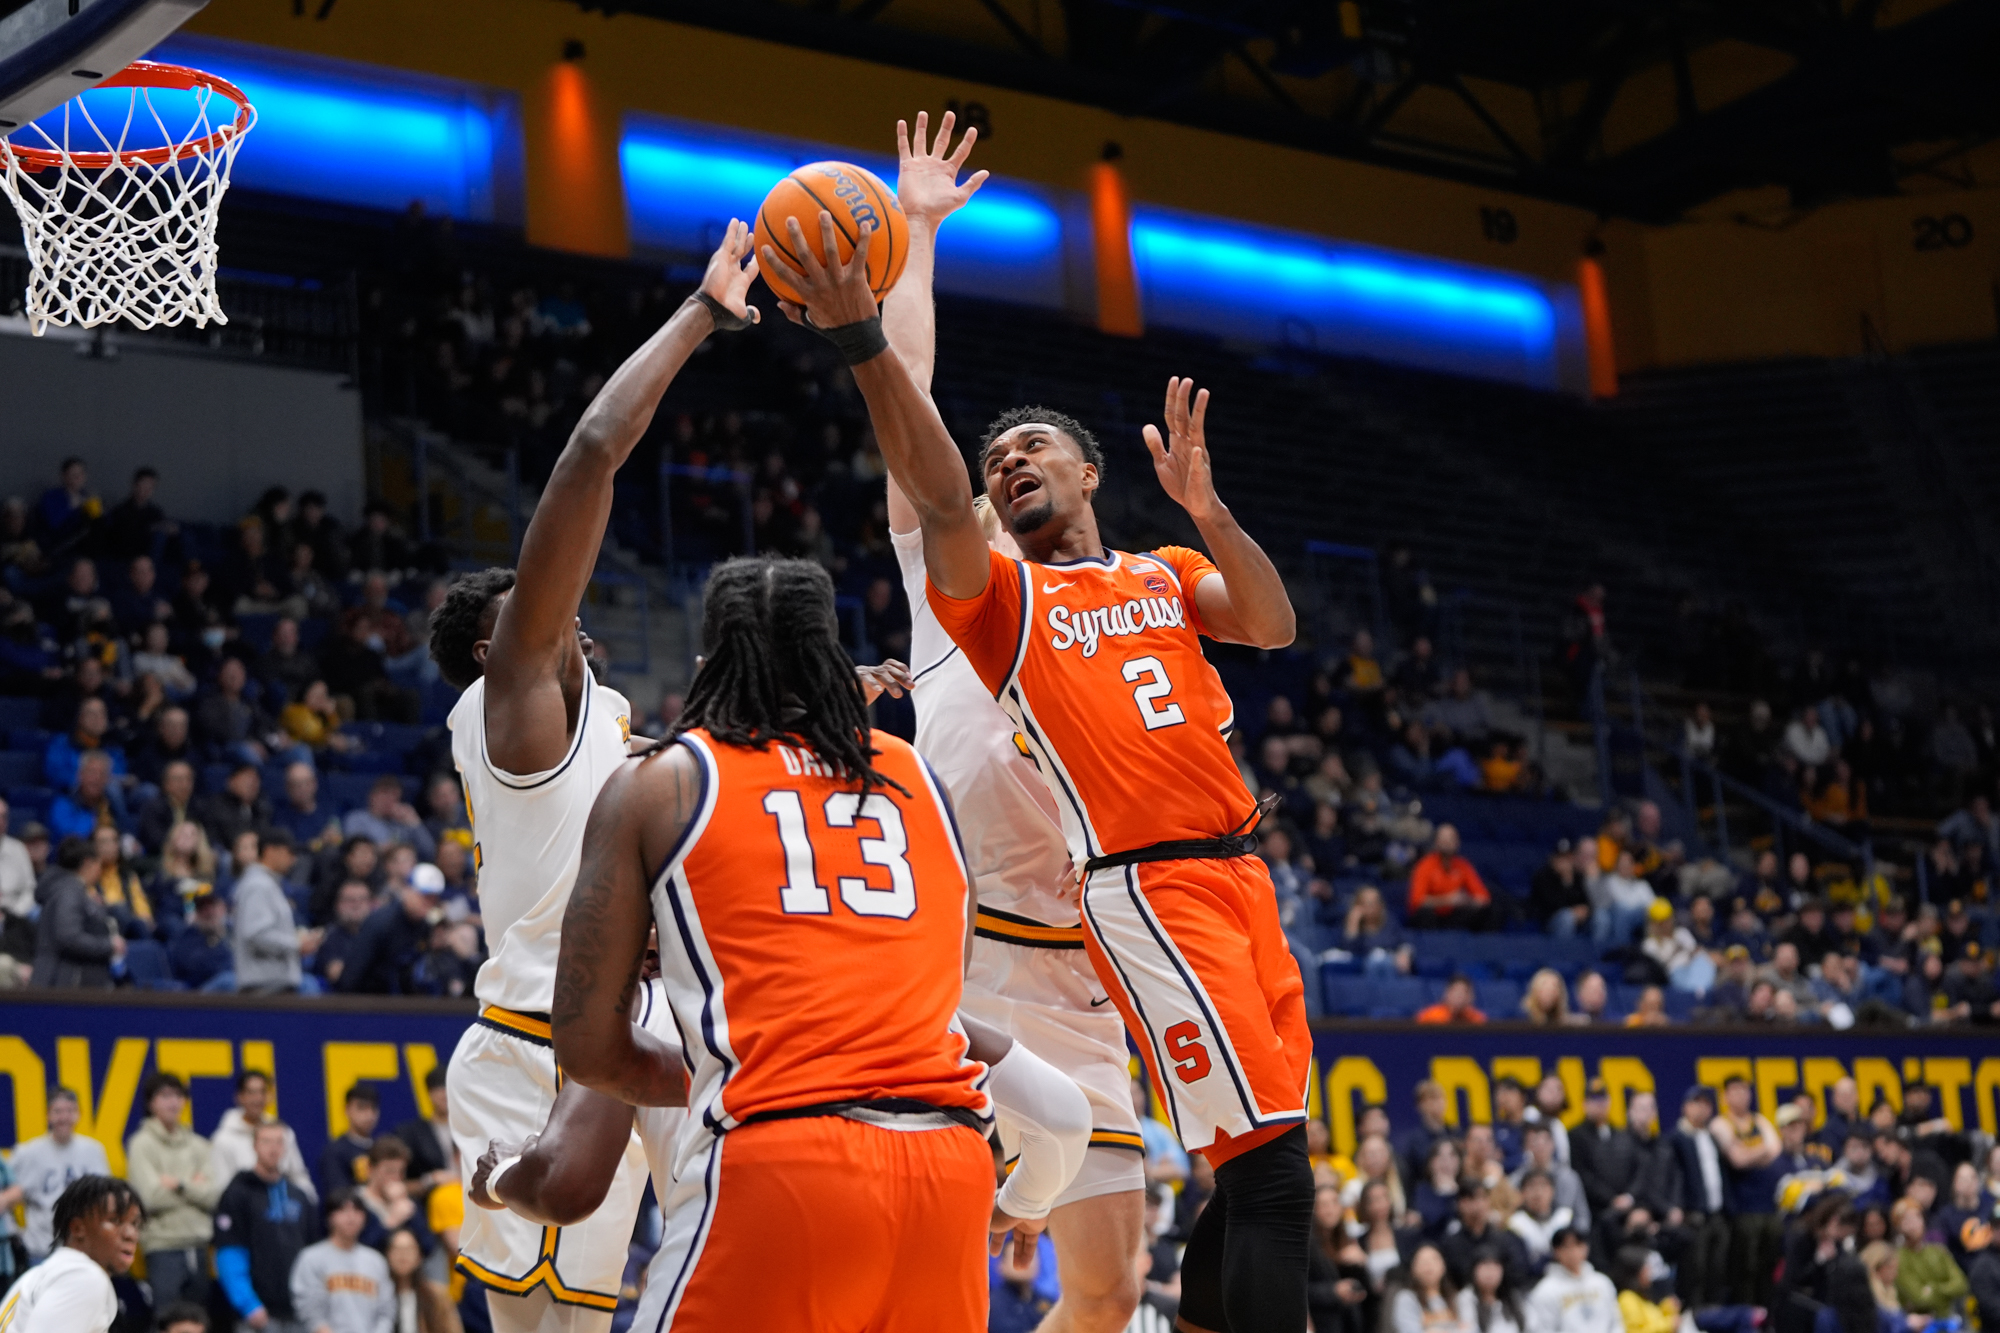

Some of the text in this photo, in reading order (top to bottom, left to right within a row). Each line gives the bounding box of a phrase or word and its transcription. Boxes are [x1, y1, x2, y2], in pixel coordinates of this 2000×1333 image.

[1479, 203, 1519, 246] 19
[1912, 212, 1975, 253] 20
[1048, 596, 1186, 658] Syracuse
[1121, 655, 1187, 732] 2
[762, 789, 918, 920] 13
[1163, 1019, 1212, 1085] S
